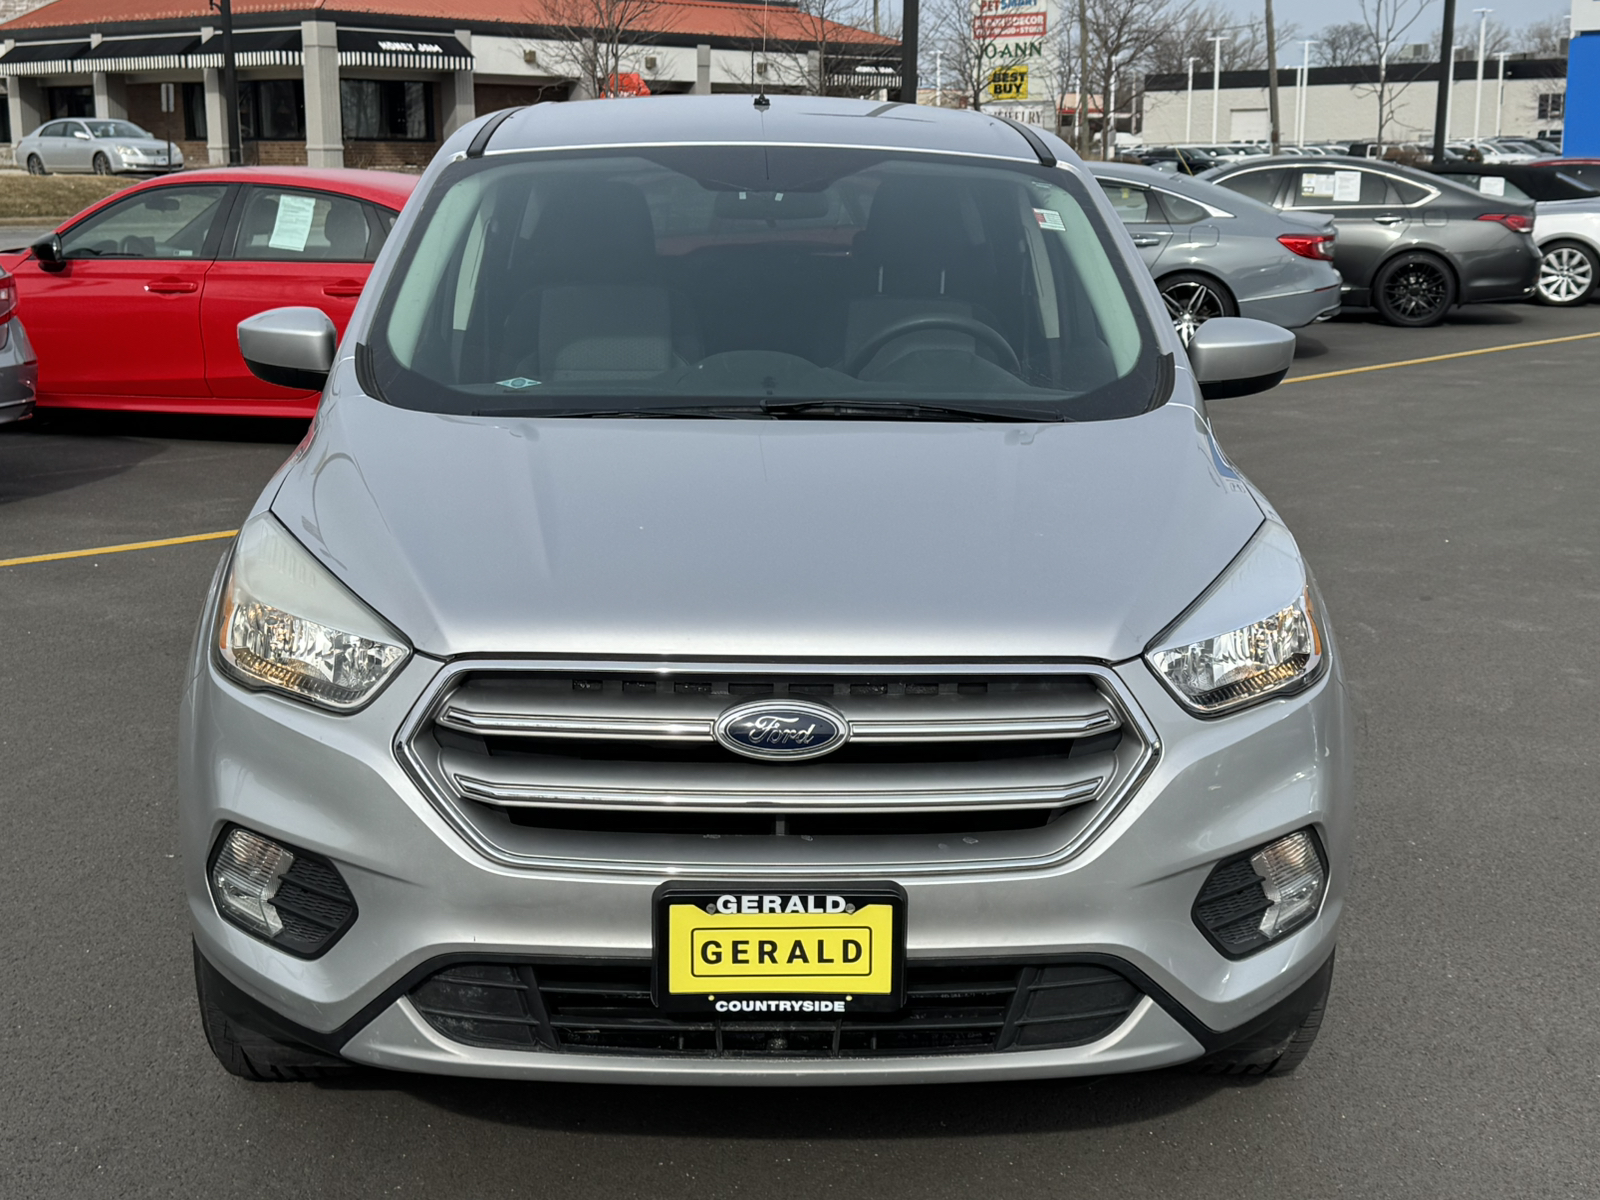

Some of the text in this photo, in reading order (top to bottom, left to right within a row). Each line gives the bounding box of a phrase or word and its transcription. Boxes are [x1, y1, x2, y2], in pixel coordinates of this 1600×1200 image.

[981, 42, 1042, 60] OANN
[993, 72, 1027, 82] BEST
[994, 83, 1023, 94] BUY
[748, 715, 816, 744] Ford
[716, 894, 847, 914] GERALD
[700, 939, 863, 965] GERALD
[715, 1000, 846, 1013] COUNTRYSIDE
